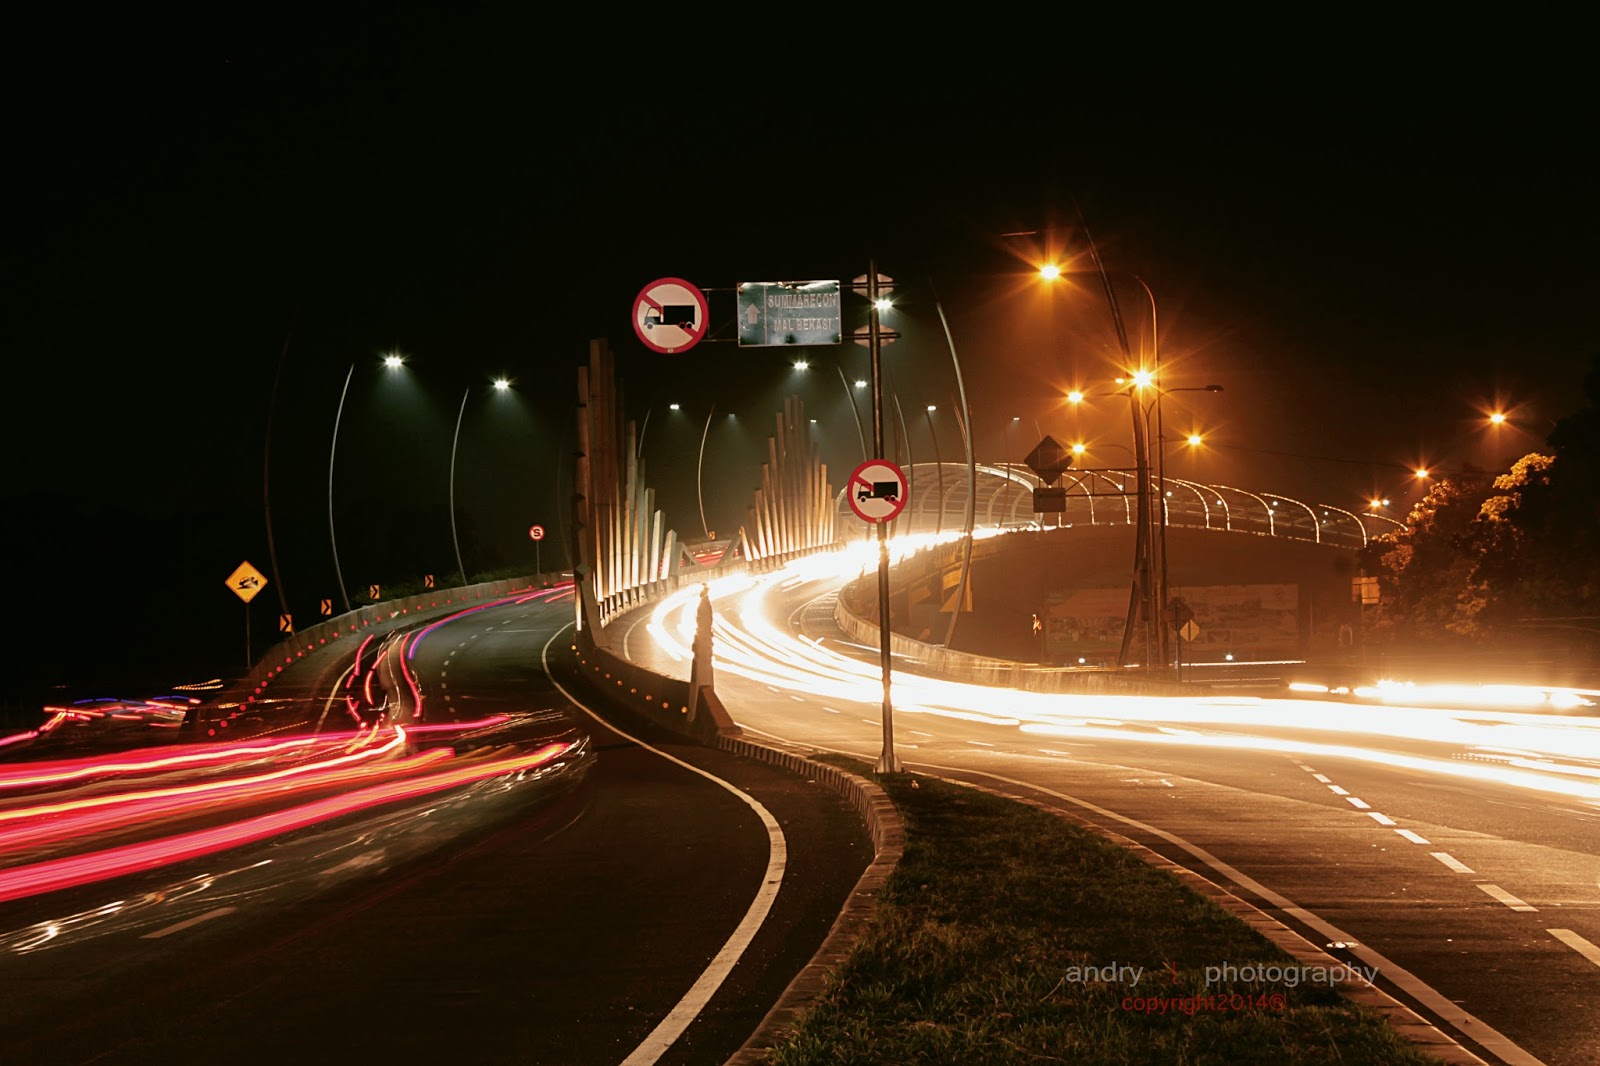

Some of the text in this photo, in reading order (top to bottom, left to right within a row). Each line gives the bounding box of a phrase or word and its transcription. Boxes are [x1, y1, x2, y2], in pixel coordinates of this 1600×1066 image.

[768, 293, 836, 309] SUMMARECON
[774, 317, 832, 332] MAL BEKASI
